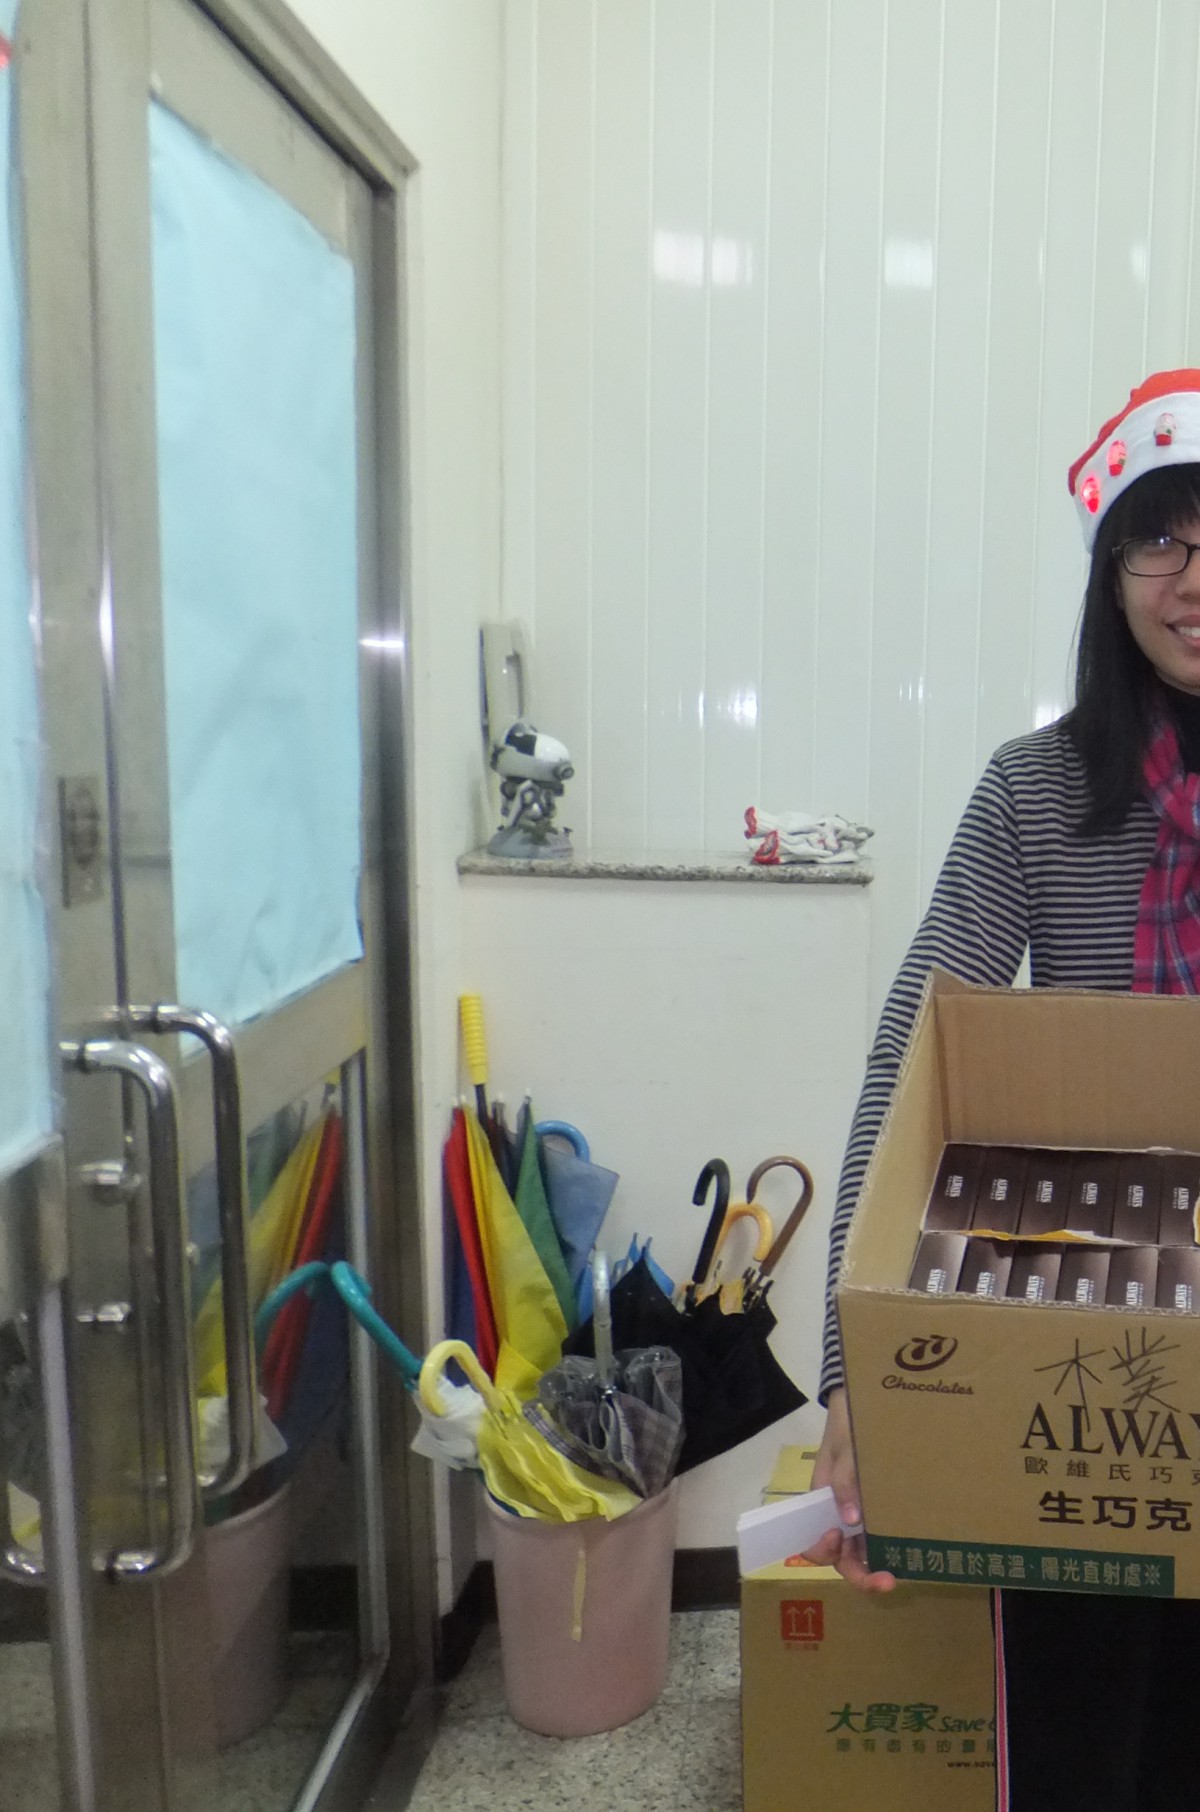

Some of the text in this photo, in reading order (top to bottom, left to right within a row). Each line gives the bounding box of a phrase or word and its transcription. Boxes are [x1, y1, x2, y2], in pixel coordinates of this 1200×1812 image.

[881, 1374, 974, 1395] Chocolates
[826, 1703, 939, 1733] 大買家
[939, 1716, 985, 1733] Save
